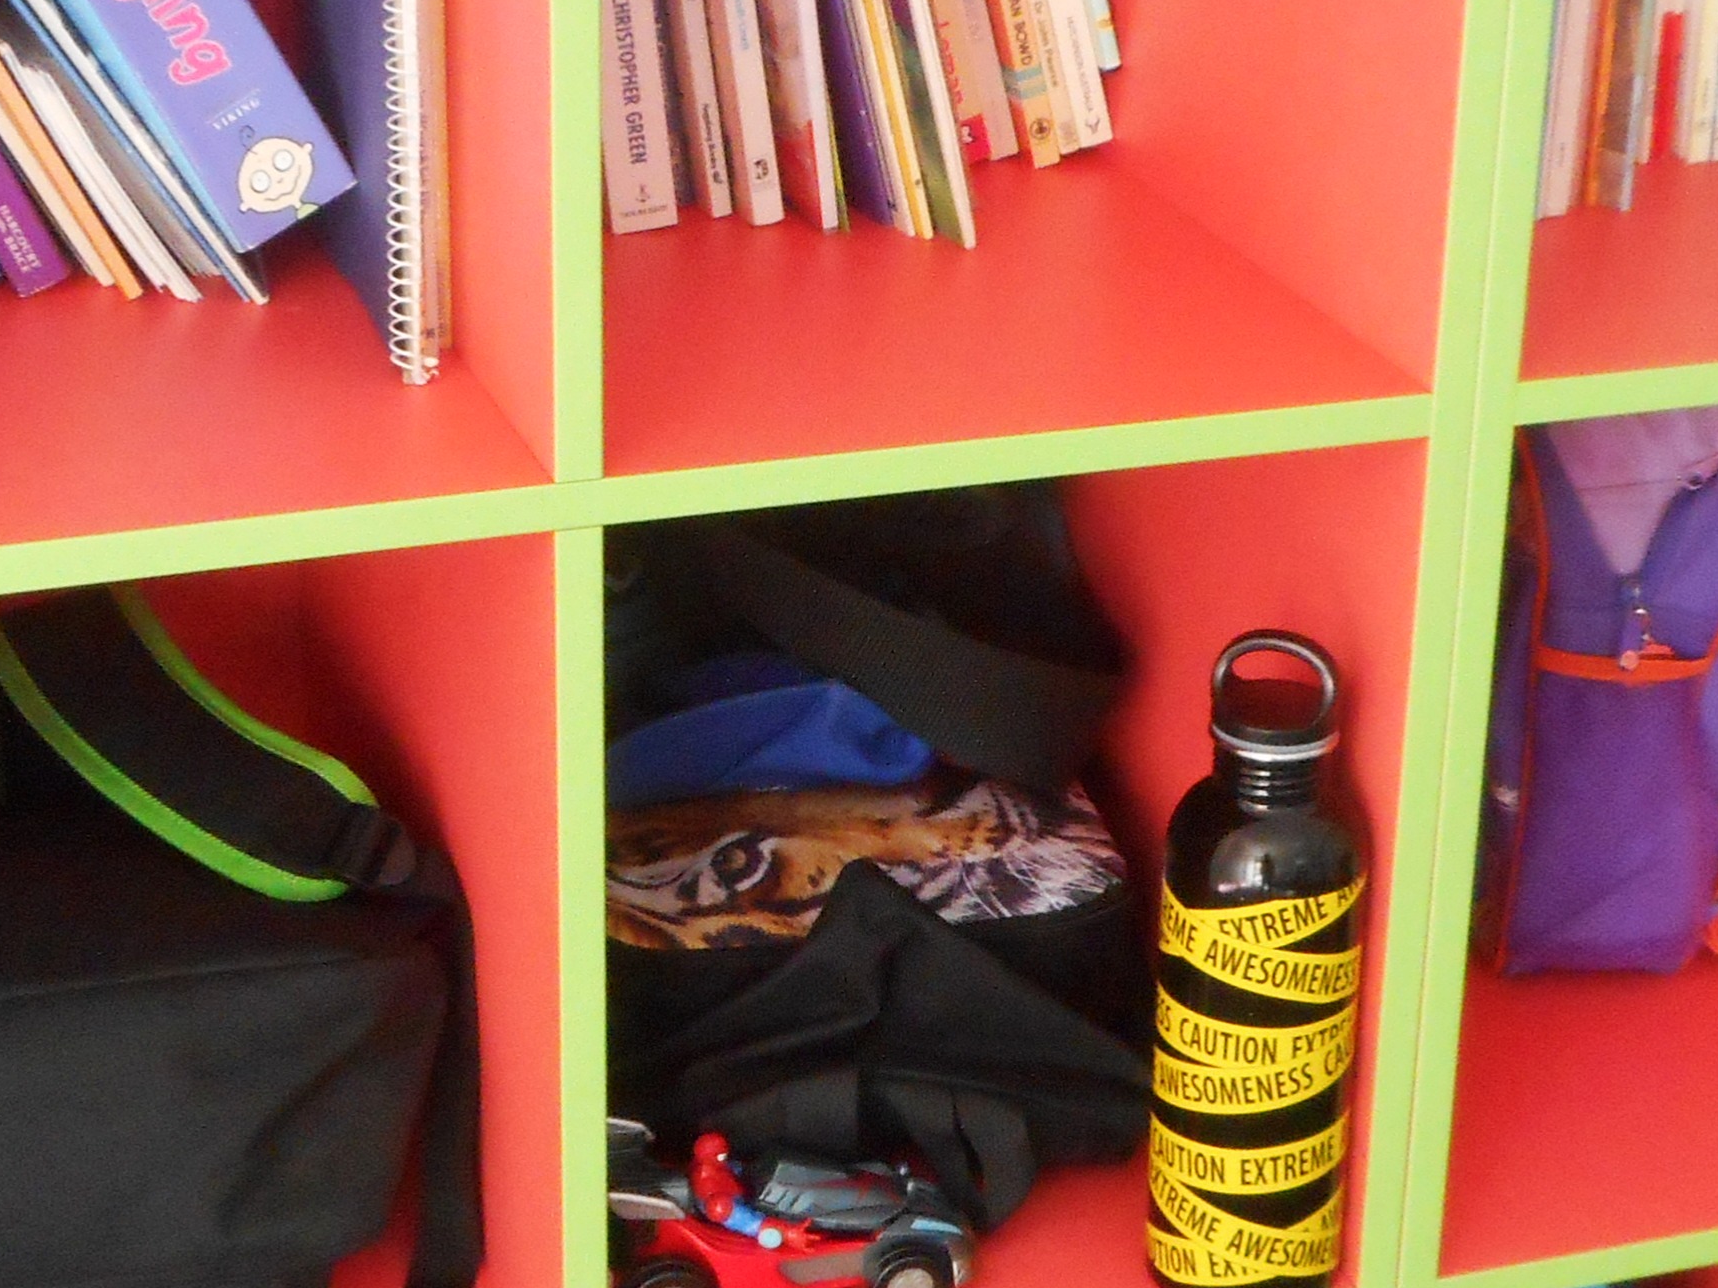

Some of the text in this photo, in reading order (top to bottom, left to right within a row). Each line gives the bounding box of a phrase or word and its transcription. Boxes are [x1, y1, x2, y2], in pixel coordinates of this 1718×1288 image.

[1012, 20, 1034, 68] BOWD
[212, 98, 261, 131] VIKING
[624, 112, 647, 165] GREEN
[1218, 895, 1328, 945] EXTREME
[1179, 1017, 1278, 1066] CAUTION
[1159, 1062, 1314, 1107] AWESOMENESS
[1240, 1135, 1336, 1186] EXTREME
